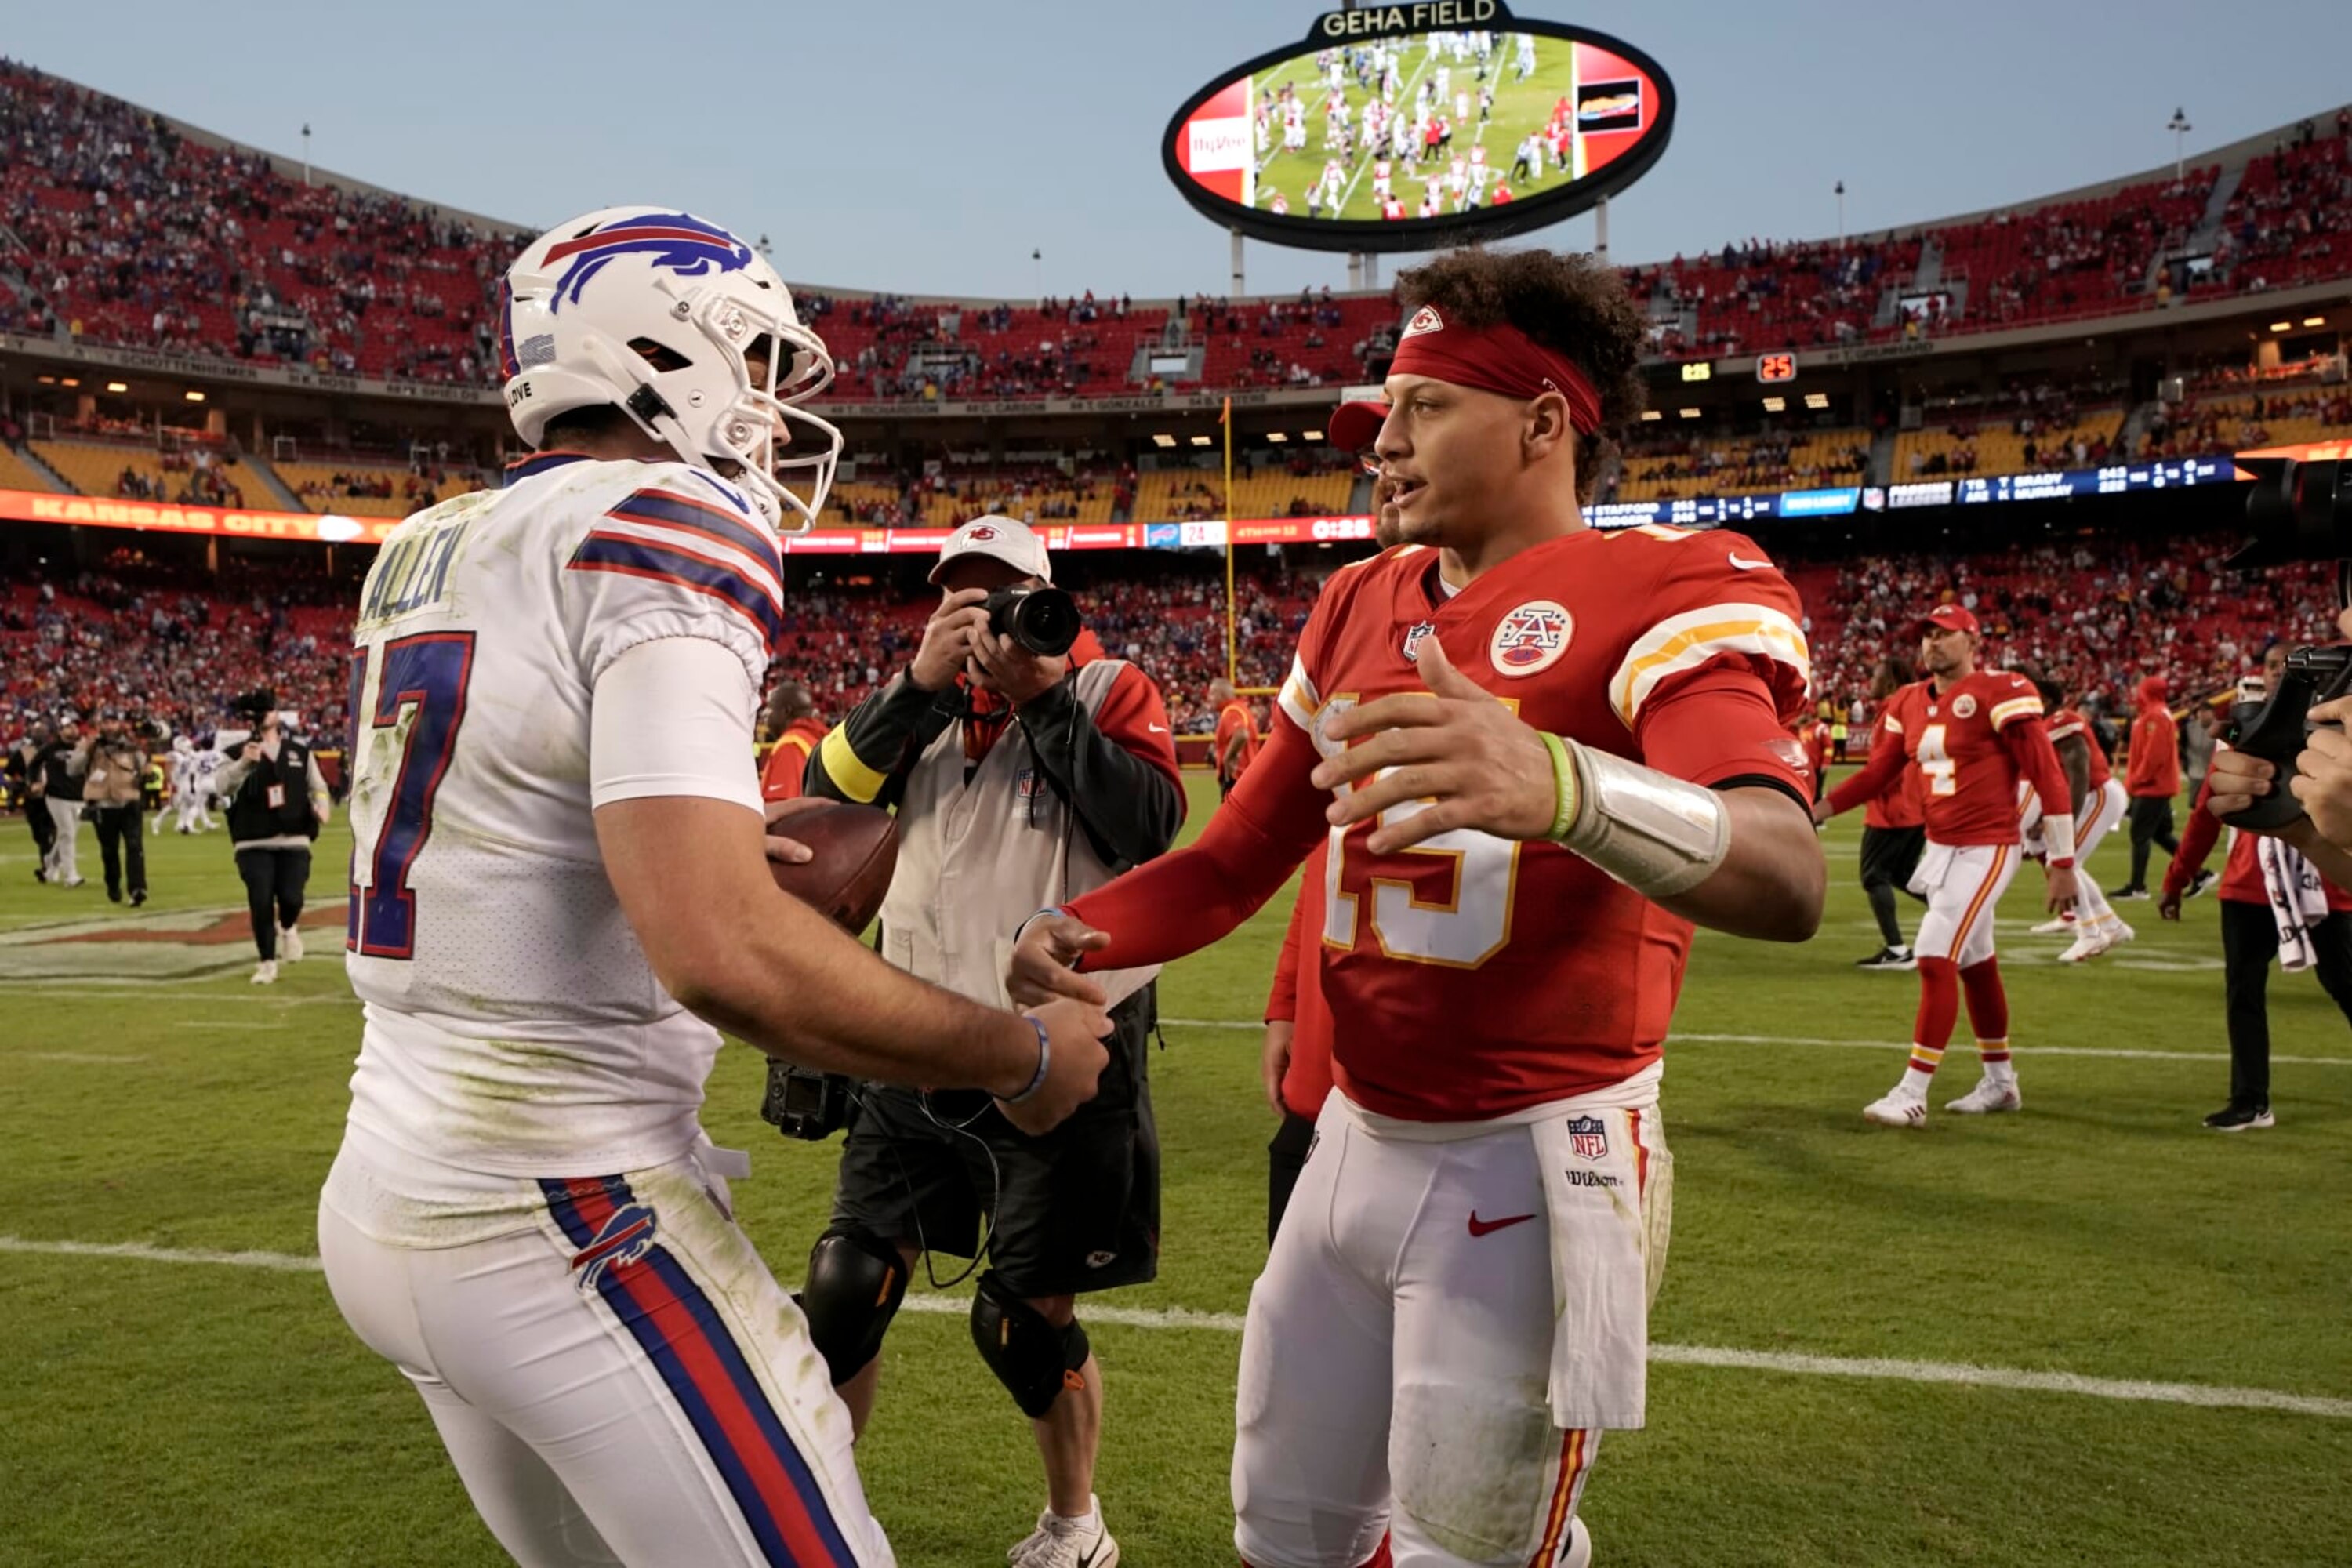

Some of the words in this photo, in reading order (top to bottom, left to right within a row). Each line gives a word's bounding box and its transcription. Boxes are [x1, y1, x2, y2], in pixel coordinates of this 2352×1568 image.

[1323, 6, 1406, 36] GEHA
[1413, 0, 1496, 27] FIELD
[1762, 355, 1792, 379] 25
[2013, 473, 2063, 488] BRADY
[2013, 484, 2074, 499] MURRAY
[32, 498, 215, 529] KANSAS
[224, 514, 319, 535] CITY
[1595, 503, 1660, 516] STAFFORD
[1189, 525, 1204, 543] 24
[1312, 518, 1371, 540] 0:25
[362, 521, 470, 622] ALLEN
[1915, 723, 1957, 797] 4
[1020, 778, 1046, 795] NL
[1572, 1134, 1605, 1158] NFL
[1565, 1170, 1618, 1188] Wilson
